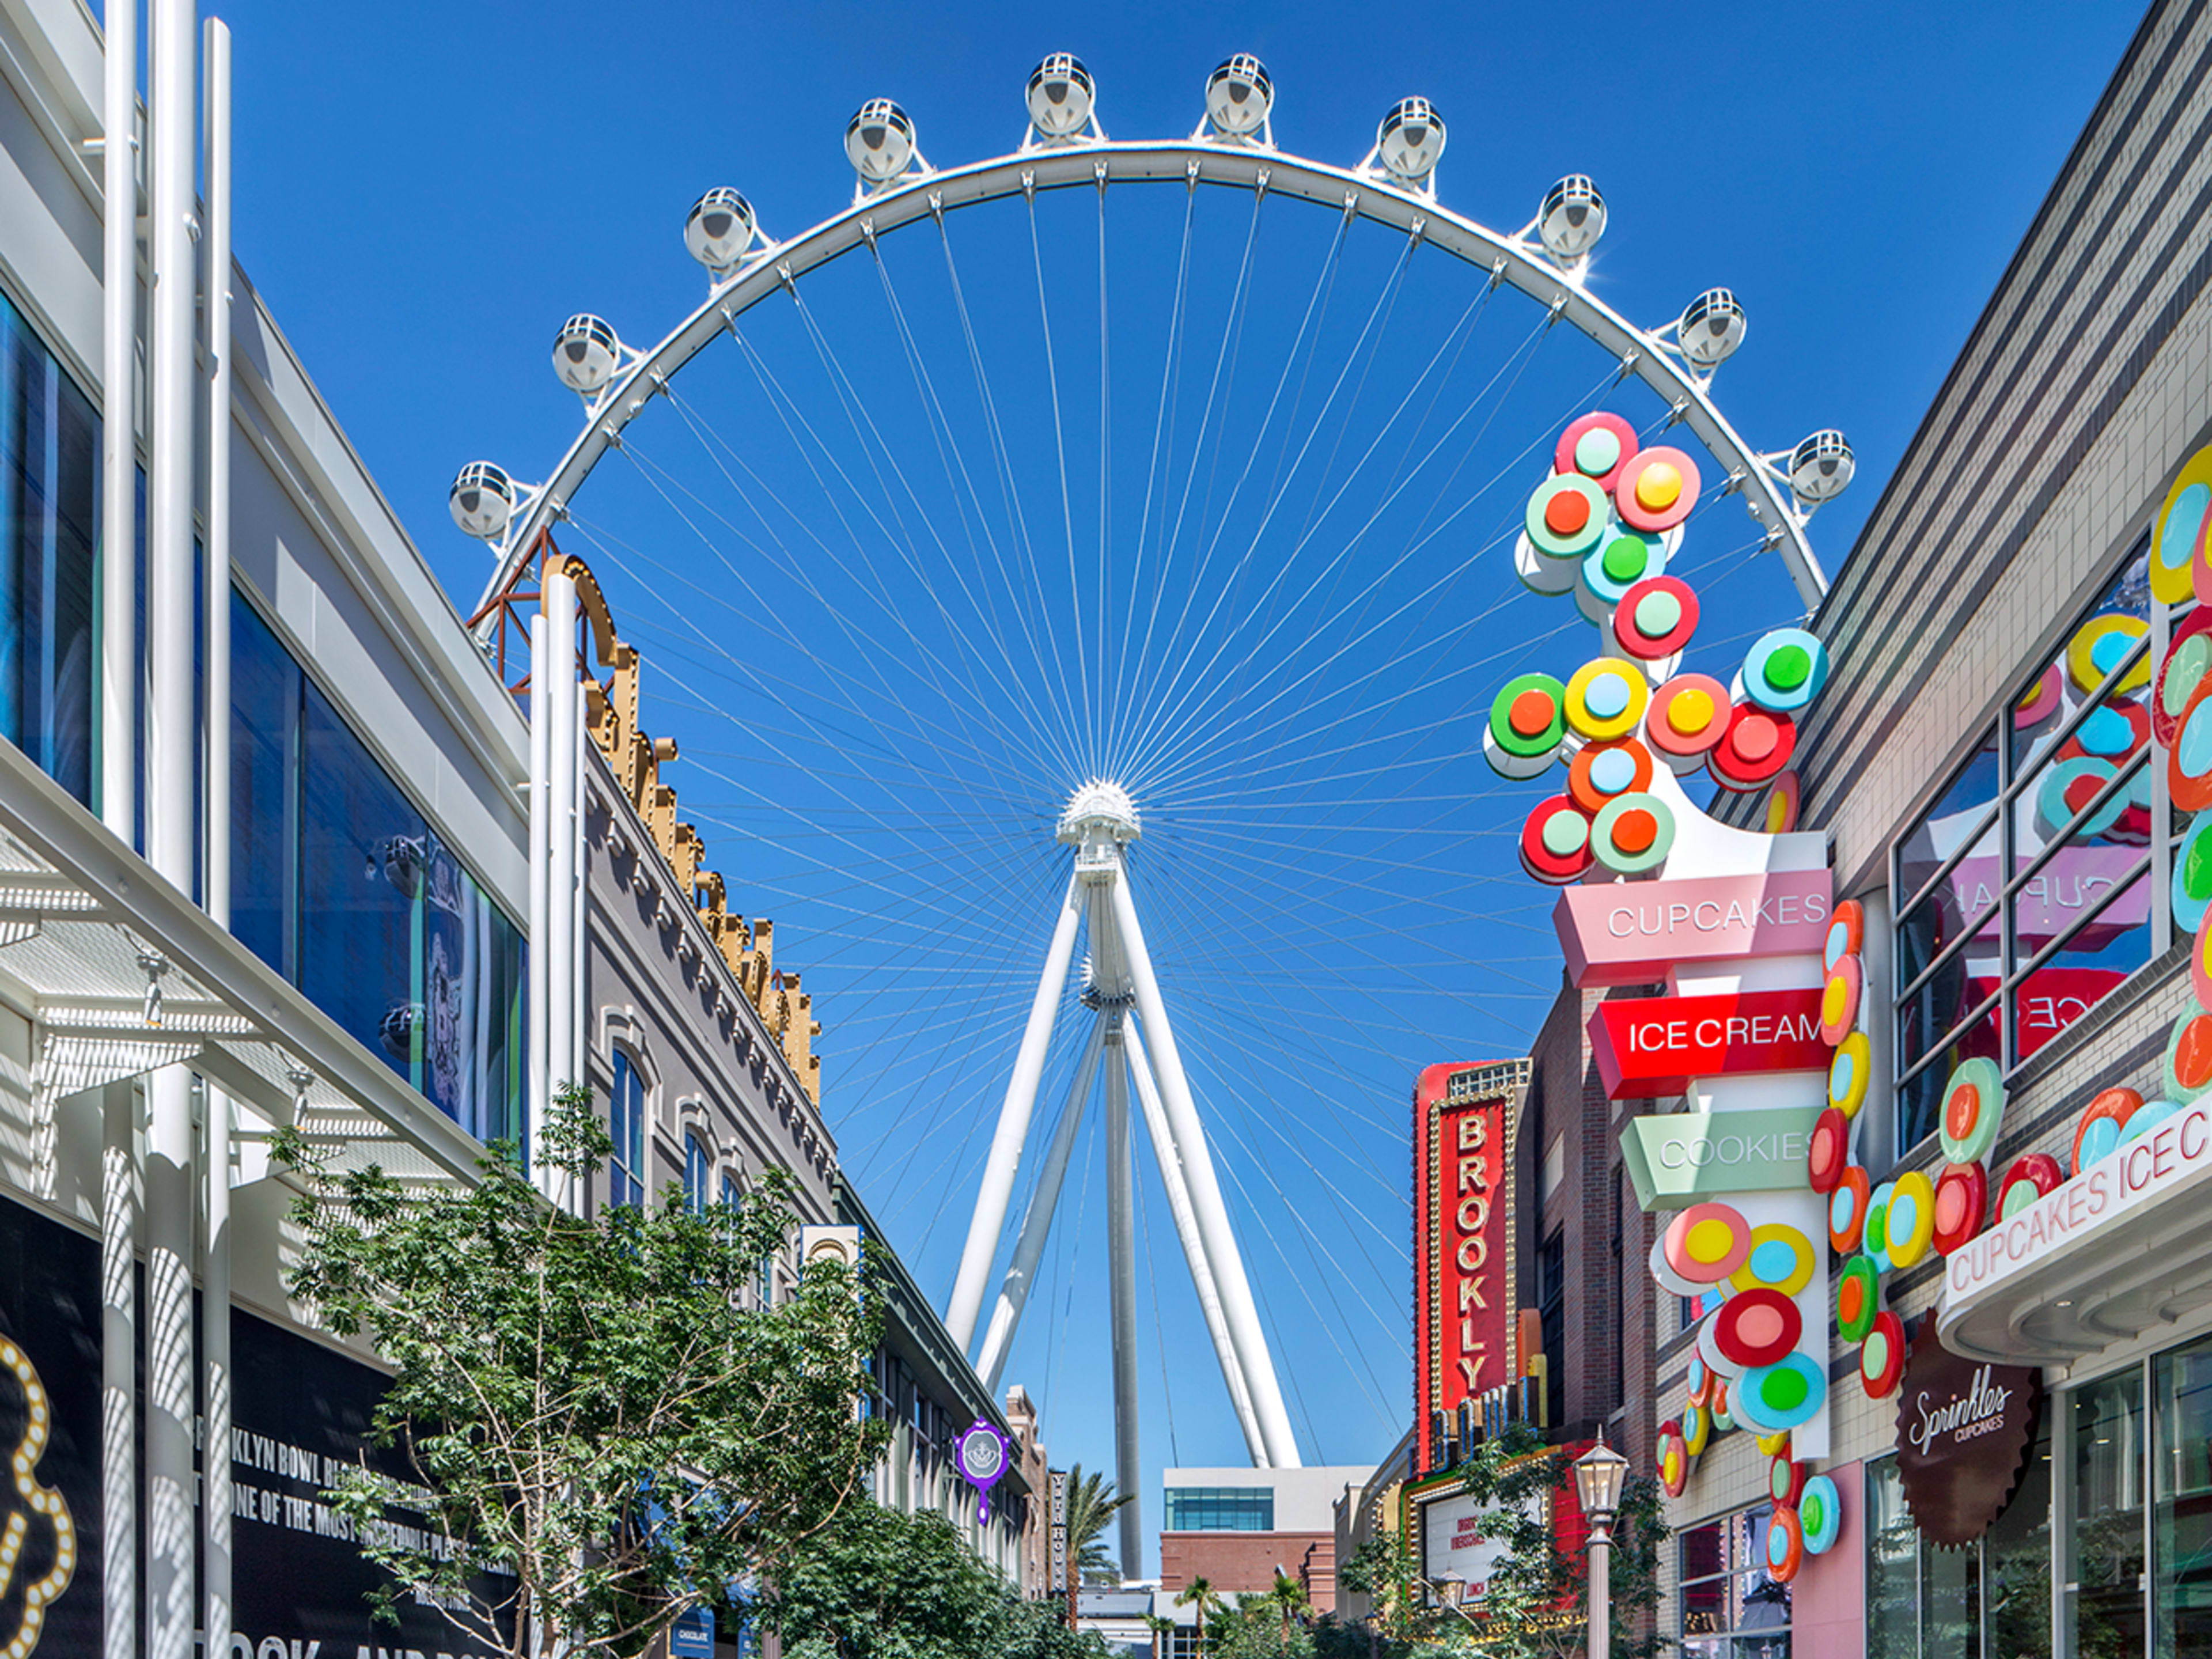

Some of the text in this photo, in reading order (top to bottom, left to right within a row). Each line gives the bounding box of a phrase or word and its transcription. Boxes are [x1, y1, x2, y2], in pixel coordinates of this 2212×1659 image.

[1608, 893, 1826, 937] CUPCAKES
[1629, 1013, 1822, 1052] ICE CREAM
[1951, 1171, 2107, 1291] CUPCAKES
[2119, 1127, 2175, 1199] ICE
[1909, 1363, 2013, 1456] Sprinkles
[1955, 1414, 2004, 1443] CUPCAKES
[278, 1441, 321, 1486] BOWL
[260, 1489, 281, 1525] OF
[283, 1494, 313, 1533] THE
